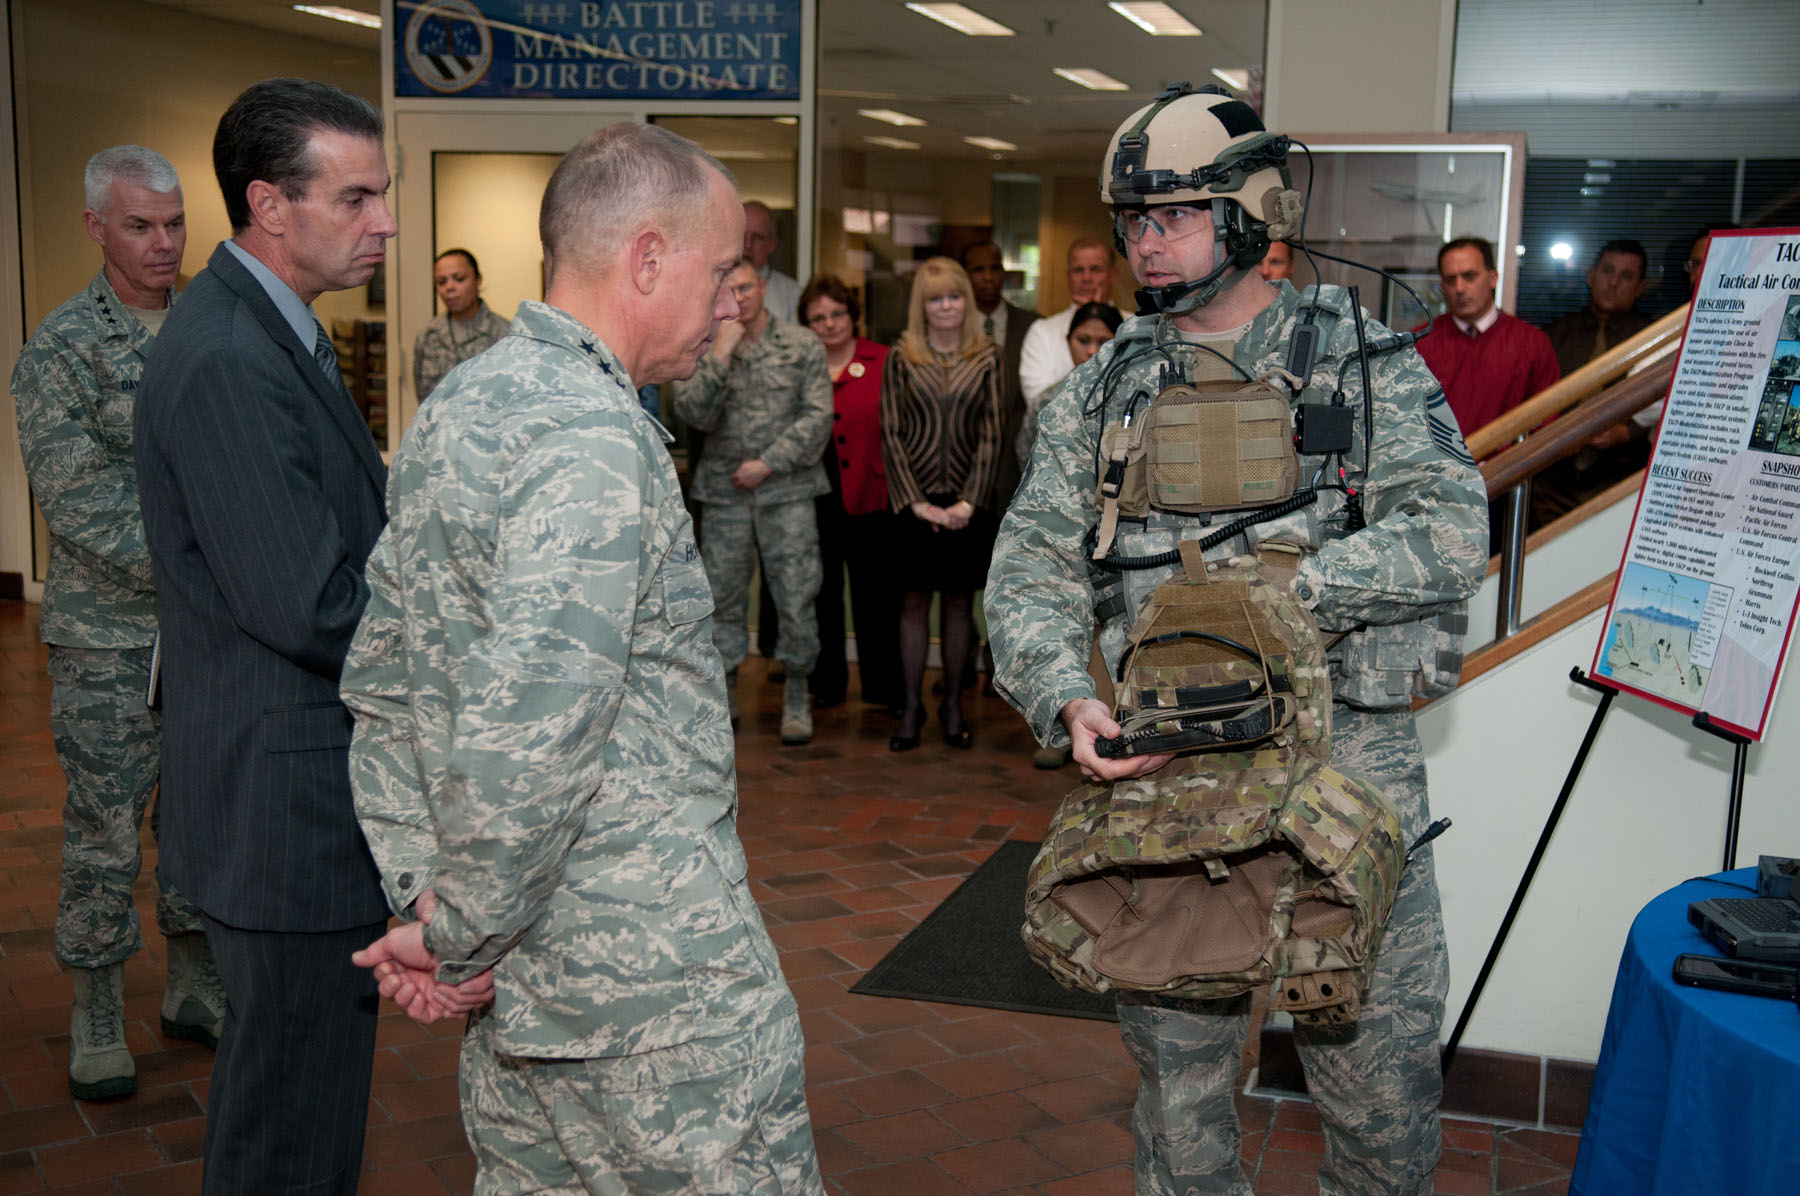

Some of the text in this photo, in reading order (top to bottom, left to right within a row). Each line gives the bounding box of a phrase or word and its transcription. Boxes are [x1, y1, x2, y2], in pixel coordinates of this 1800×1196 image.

[580, 2, 716, 29] BATTLE
[513, 32, 788, 60] MANAGEMENT
[512, 62, 788, 91] DIRECTORATE
[1718, 273, 1760, 289] Tactical
[1761, 273, 1779, 290] Air
[1697, 298, 1746, 310] DESCRIPTION
[1652, 464, 1712, 483] RECENT SUCCESS
[1761, 460, 1800, 476] SNAPSHO
[1760, 496, 1778, 504] Combat
[1757, 507, 1777, 516] National
[1778, 510, 1794, 519] Guard
[1745, 516, 1761, 524] Pacific
[1771, 522, 1787, 530] Forces
[1740, 538, 1764, 548] Command
[1761, 530, 1777, 540] Forces
[1779, 535, 1798, 544] Central
[1755, 552, 1771, 561] Forces
[1772, 556, 1790, 566] Europe
[1755, 566, 1794, 581] Rockwell Collins
[1752, 577, 1774, 590] Northrop
[1749, 588, 1772, 600] Grumman
[1745, 599, 1761, 609] Harris
[1751, 612, 1768, 623] Insight
